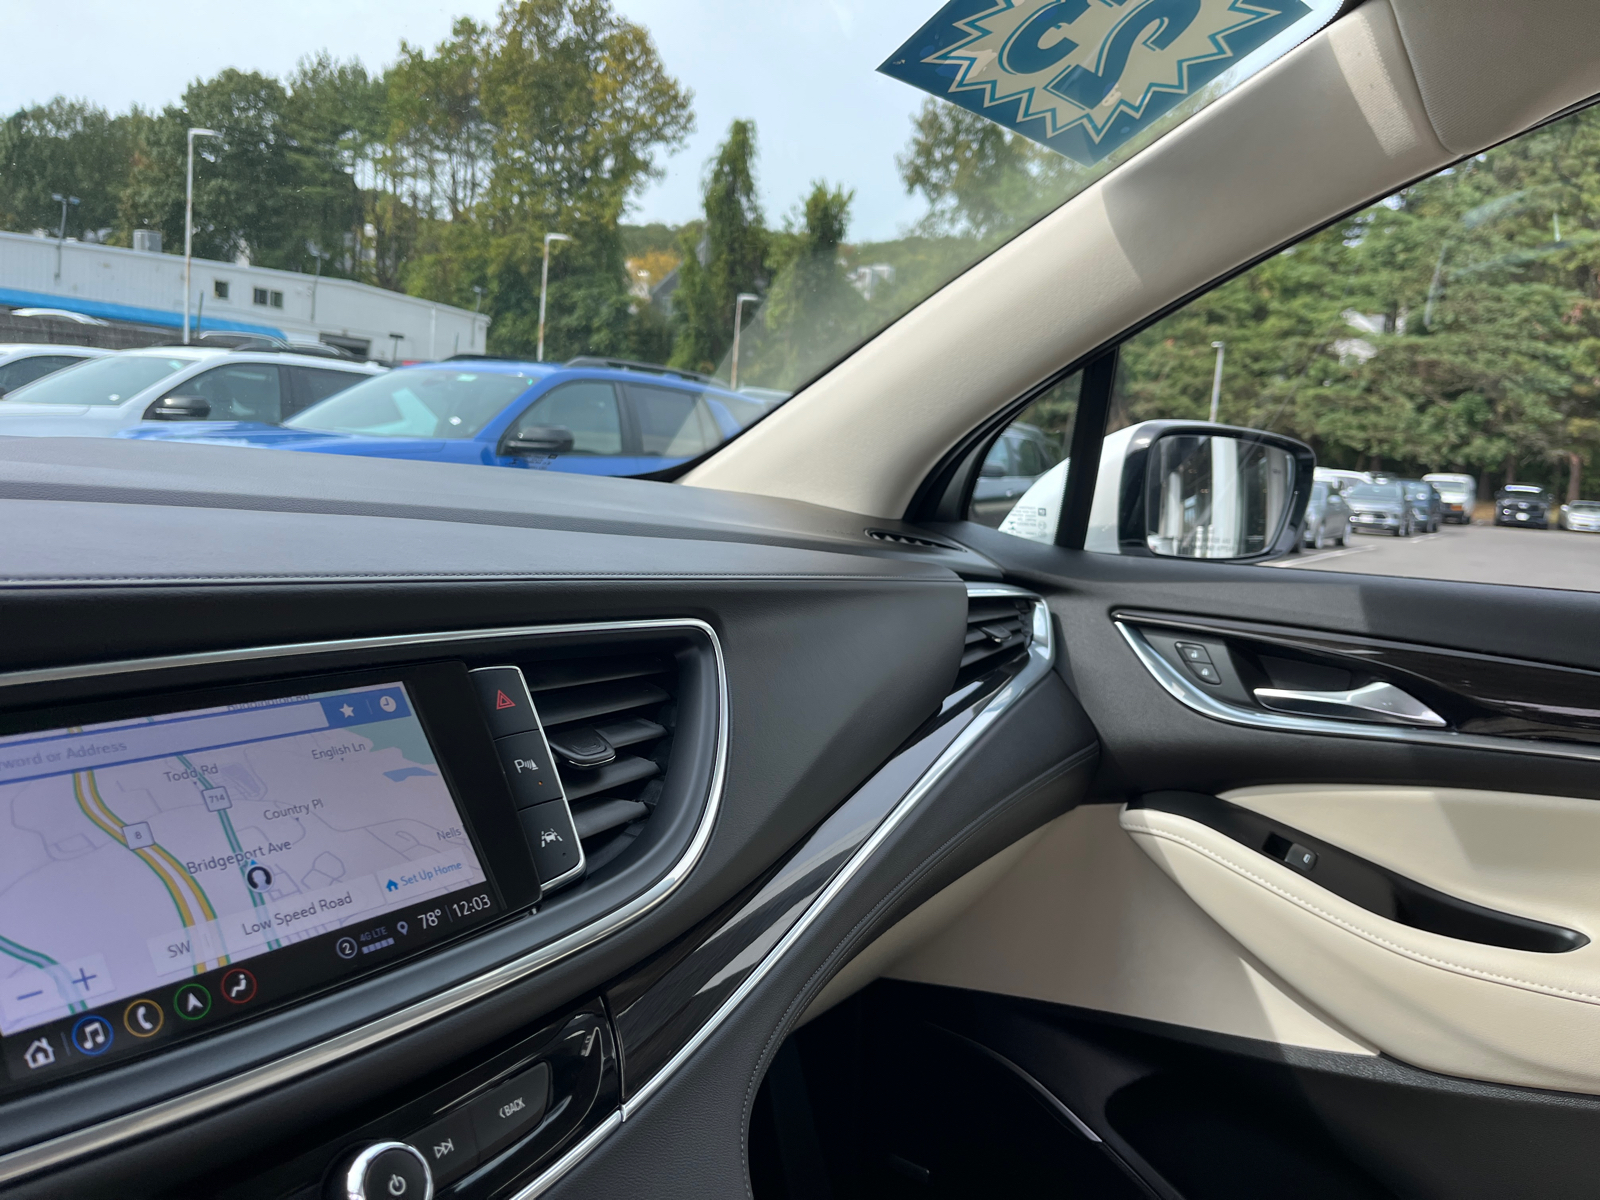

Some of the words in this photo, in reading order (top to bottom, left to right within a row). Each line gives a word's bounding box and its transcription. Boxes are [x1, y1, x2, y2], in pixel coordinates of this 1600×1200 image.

[46, 753, 61, 763] or
[66, 742, 128, 759] Address
[311, 743, 350, 760] English
[352, 741, 366, 753] Ln
[163, 767, 198, 782] Todd
[200, 763, 219, 775] Rd
[208, 794, 226, 803] 714
[263, 801, 310, 820] Country
[312, 798, 324, 809] Pl
[135, 831, 142, 840] 8
[436, 827, 462, 841] Nells
[186, 846, 266, 874] Bridgeport
[268, 841, 292, 854] Ave
[400, 874, 417, 887] Set
[418, 869, 434, 881] Up
[433, 862, 463, 876] Home
[242, 919, 272, 935] Low
[274, 905, 316, 926] Speed
[319, 892, 353, 911] Road
[452, 894, 491, 918] 12:03
[417, 909, 442, 930] 78°
[360, 931, 371, 942] 4G
[372, 926, 388, 938] LTE
[167, 940, 191, 959] SW
[342, 942, 353, 954] 2
[504, 1097, 526, 1116] BACK
